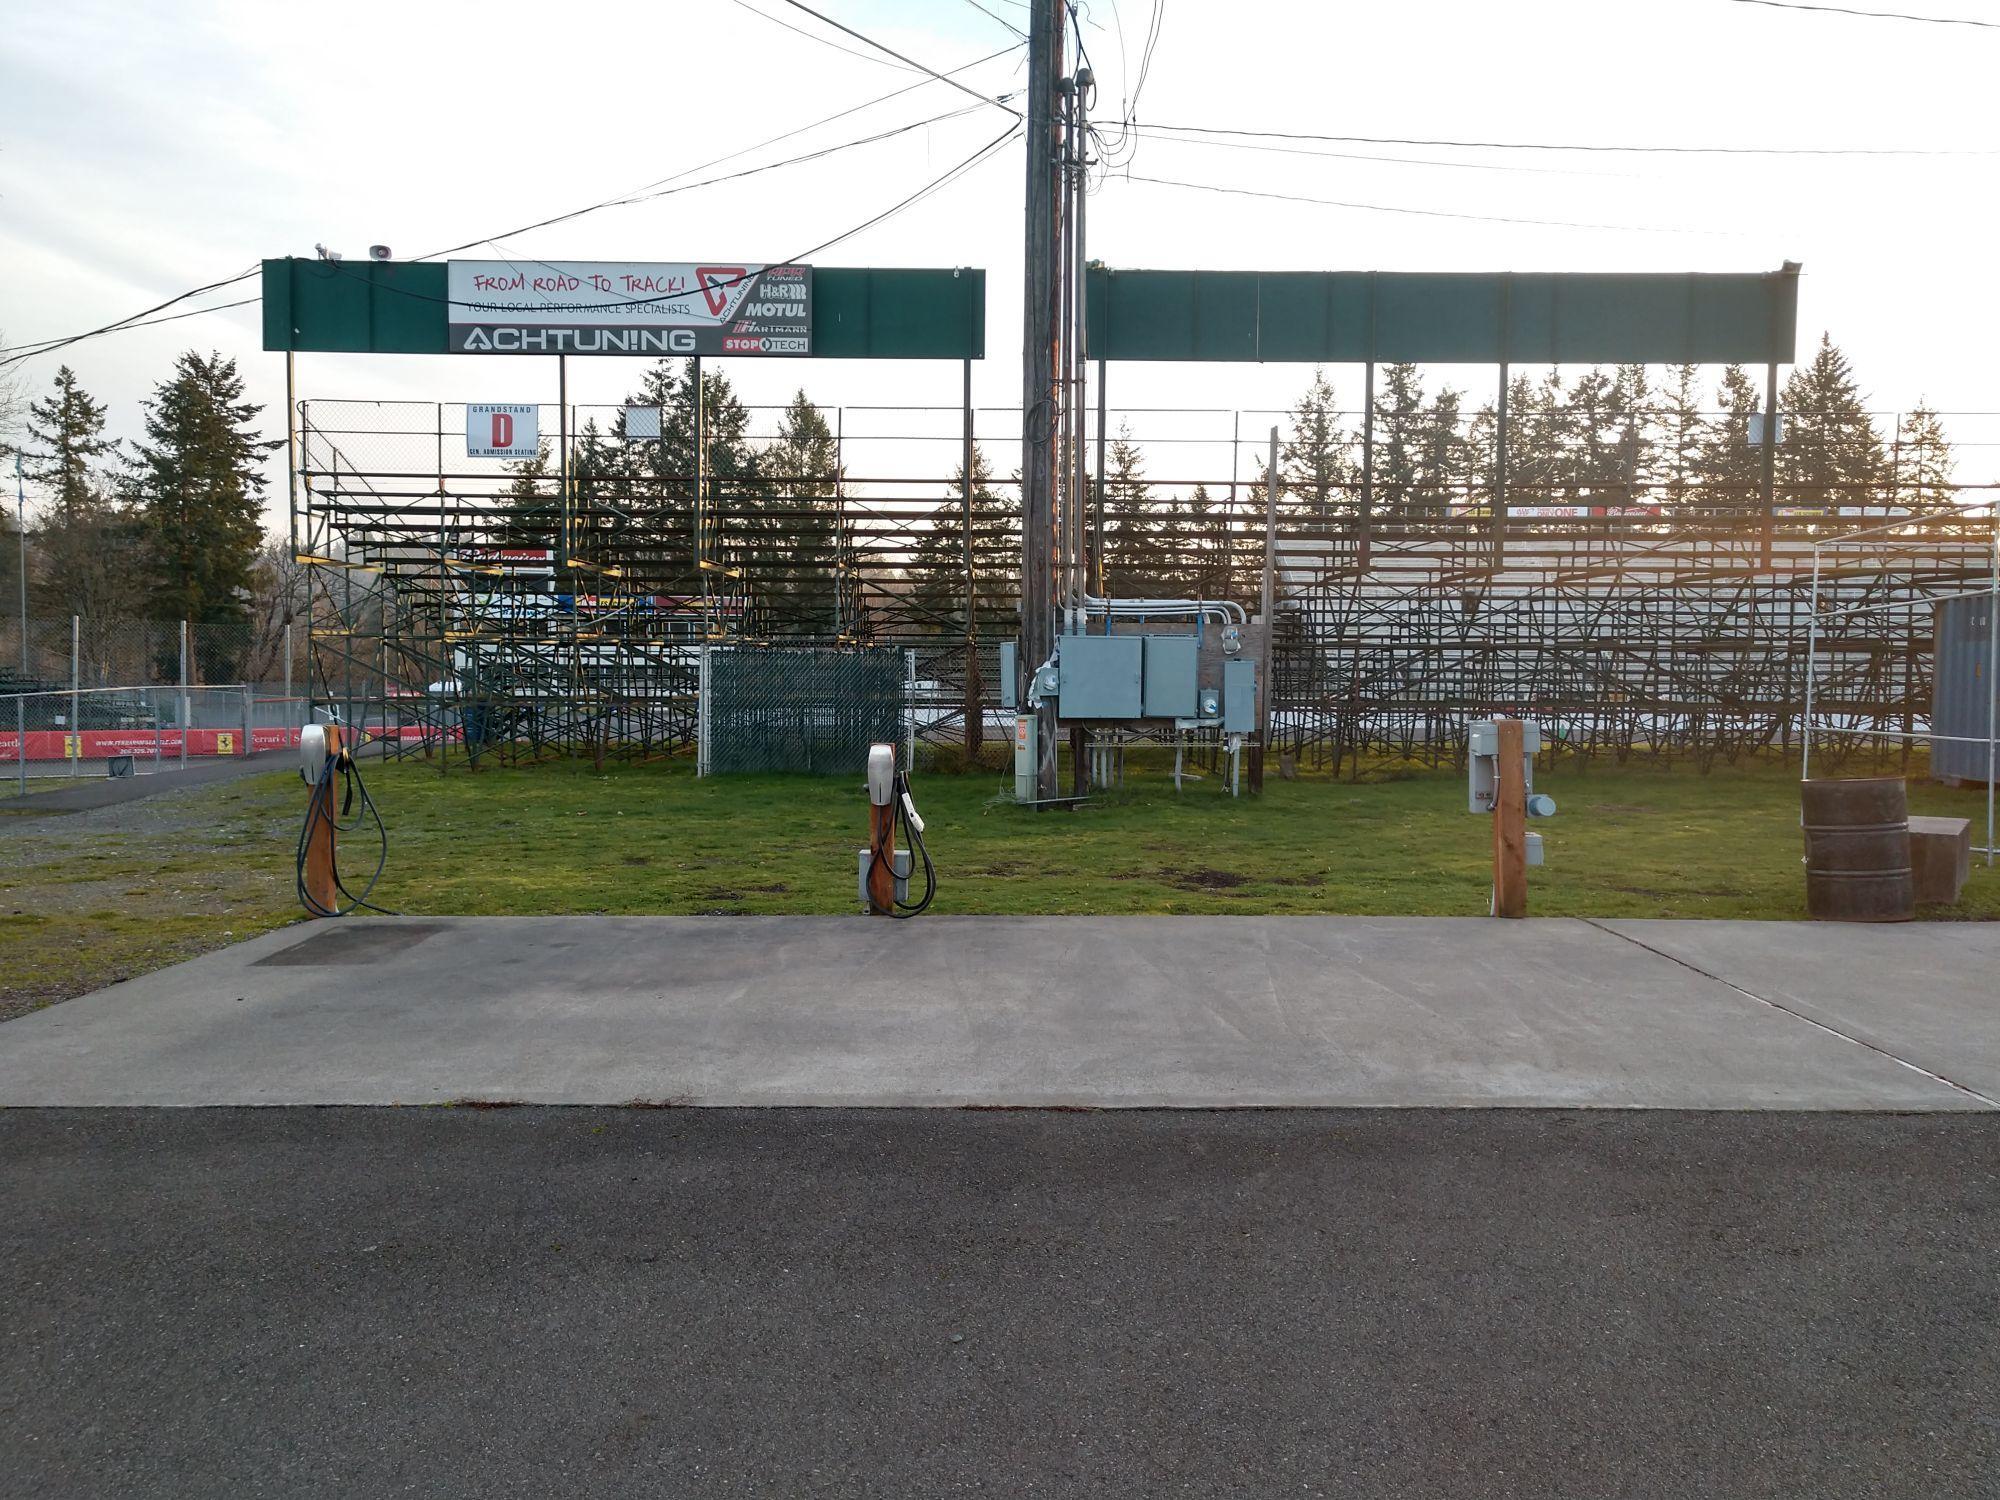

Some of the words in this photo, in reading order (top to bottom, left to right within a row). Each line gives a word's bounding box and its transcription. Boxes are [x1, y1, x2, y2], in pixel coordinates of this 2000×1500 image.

[474, 273, 525, 291] FROM
[533, 275, 580, 292] ROAD
[588, 274, 612, 292] TO
[501, 302, 533, 313] LOCAL
[540, 302, 621, 314] PERFORMANCE
[625, 304, 691, 315] SPECIALISTS
[745, 303, 807, 317] MOTUL
[492, 413, 513, 448] D
[483, 448, 513, 456] ADMISSION
[1555, 507, 1578, 518] ONE
